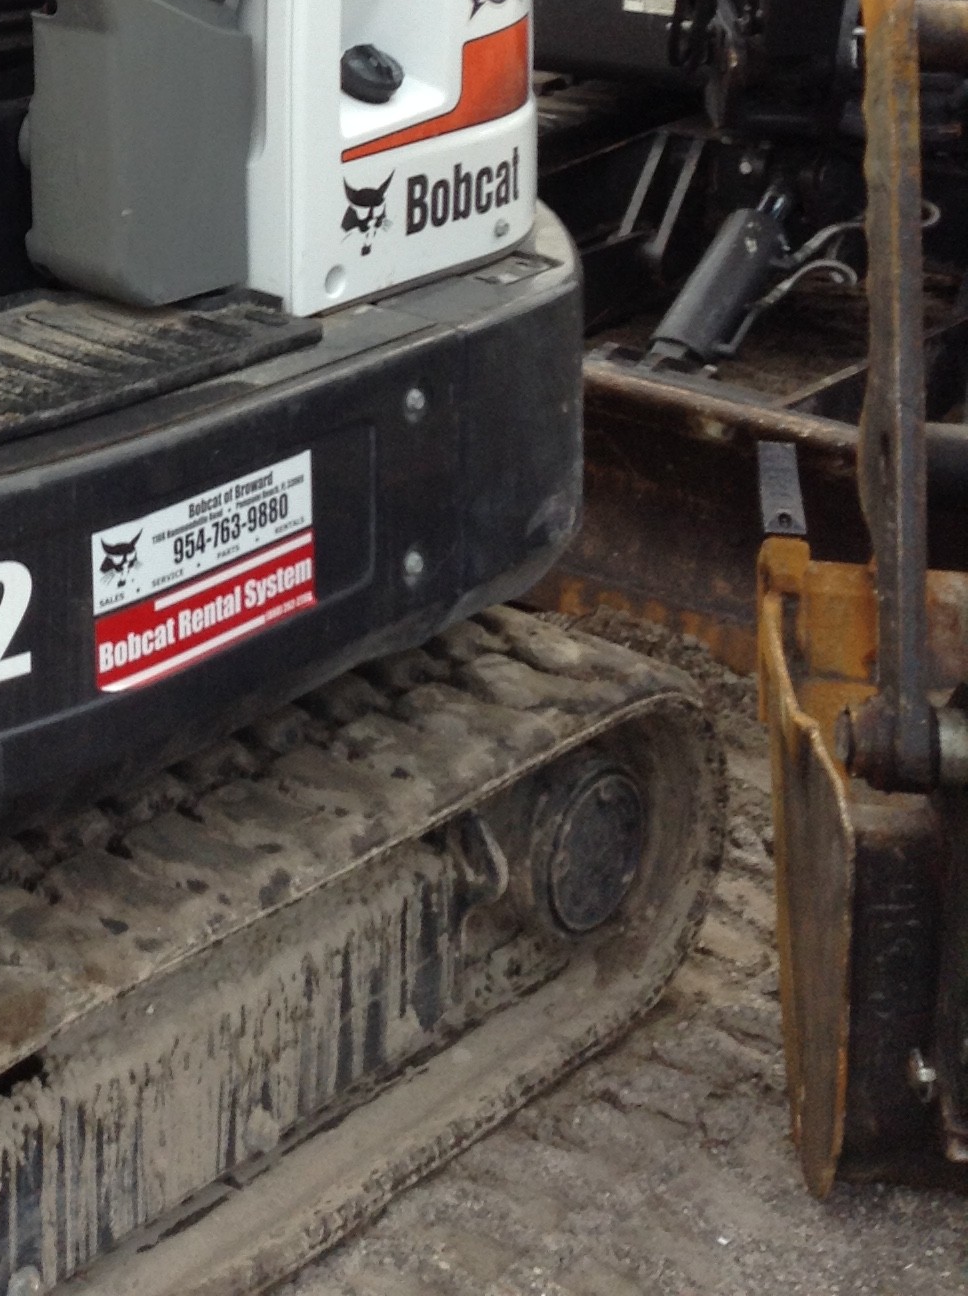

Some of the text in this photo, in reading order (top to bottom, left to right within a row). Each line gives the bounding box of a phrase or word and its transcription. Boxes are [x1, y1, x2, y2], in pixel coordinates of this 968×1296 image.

[405, 146, 520, 237] Bobcat
[172, 492, 289, 565] 954-763-9880
[188, 492, 222, 519] Bobcat
[223, 486, 234, 504] of
[234, 470, 274, 500] Broward
[99, 592, 125, 608] SALES
[151, 568, 185, 588] SERVICE
[216, 544, 240, 559] PARTS
[98, 618, 176, 674] Bobcat
[178, 585, 242, 641] Rental
[243, 556, 313, 609] System
